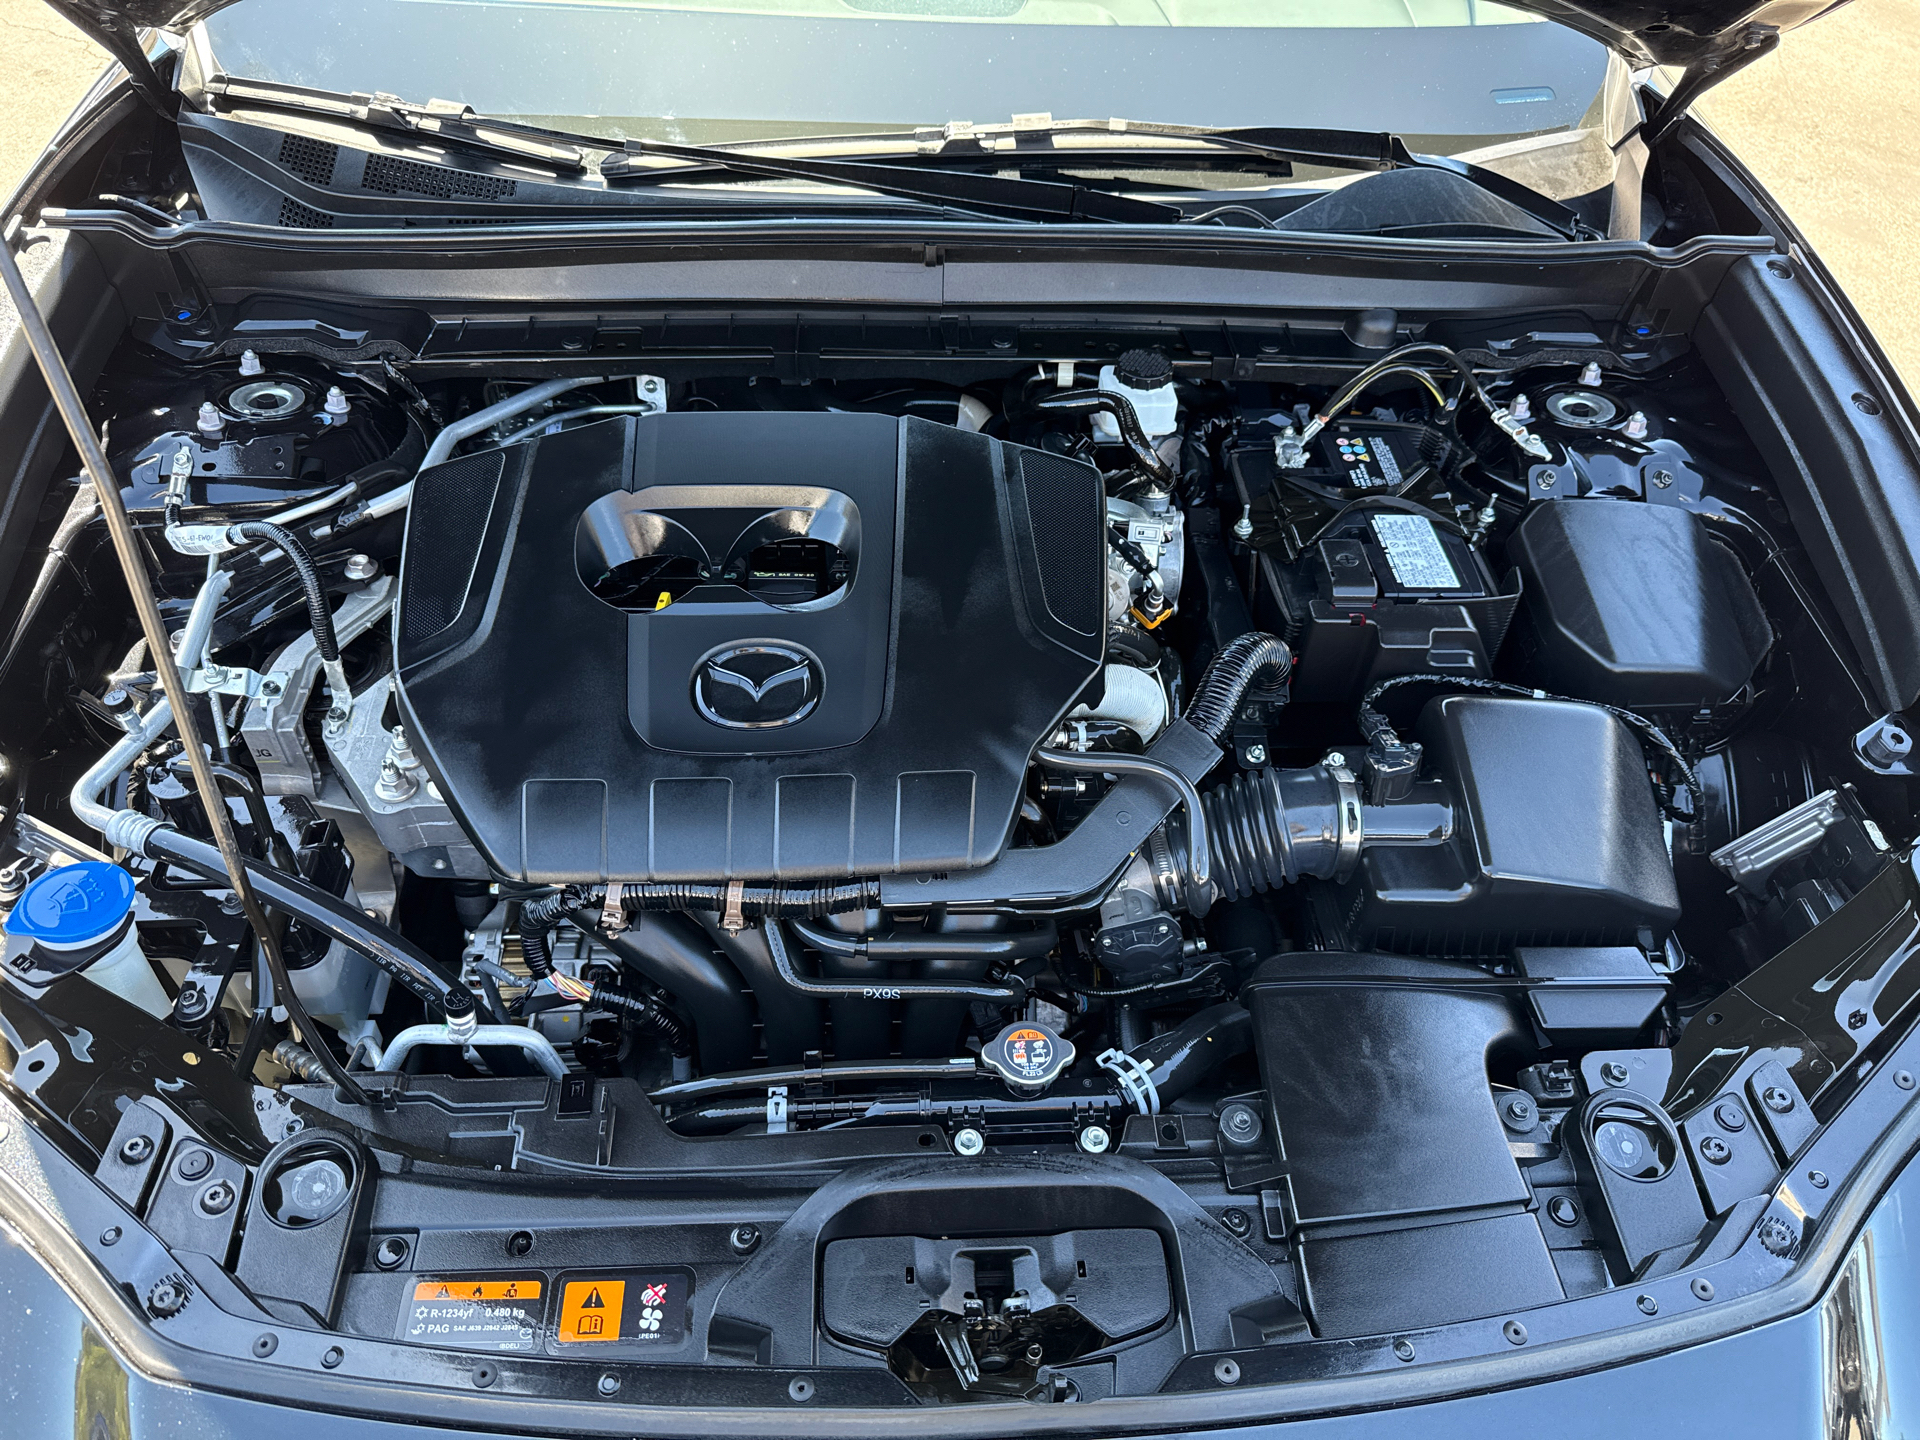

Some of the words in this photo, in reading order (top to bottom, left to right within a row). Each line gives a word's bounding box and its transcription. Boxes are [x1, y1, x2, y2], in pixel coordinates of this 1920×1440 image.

[863, 988, 901, 1000] PX9S
[430, 1308, 474, 1320] R-1234yf
[485, 1308, 511, 1318] 0.480
[512, 1307, 525, 1319] kg
[427, 1323, 450, 1333] PAG
